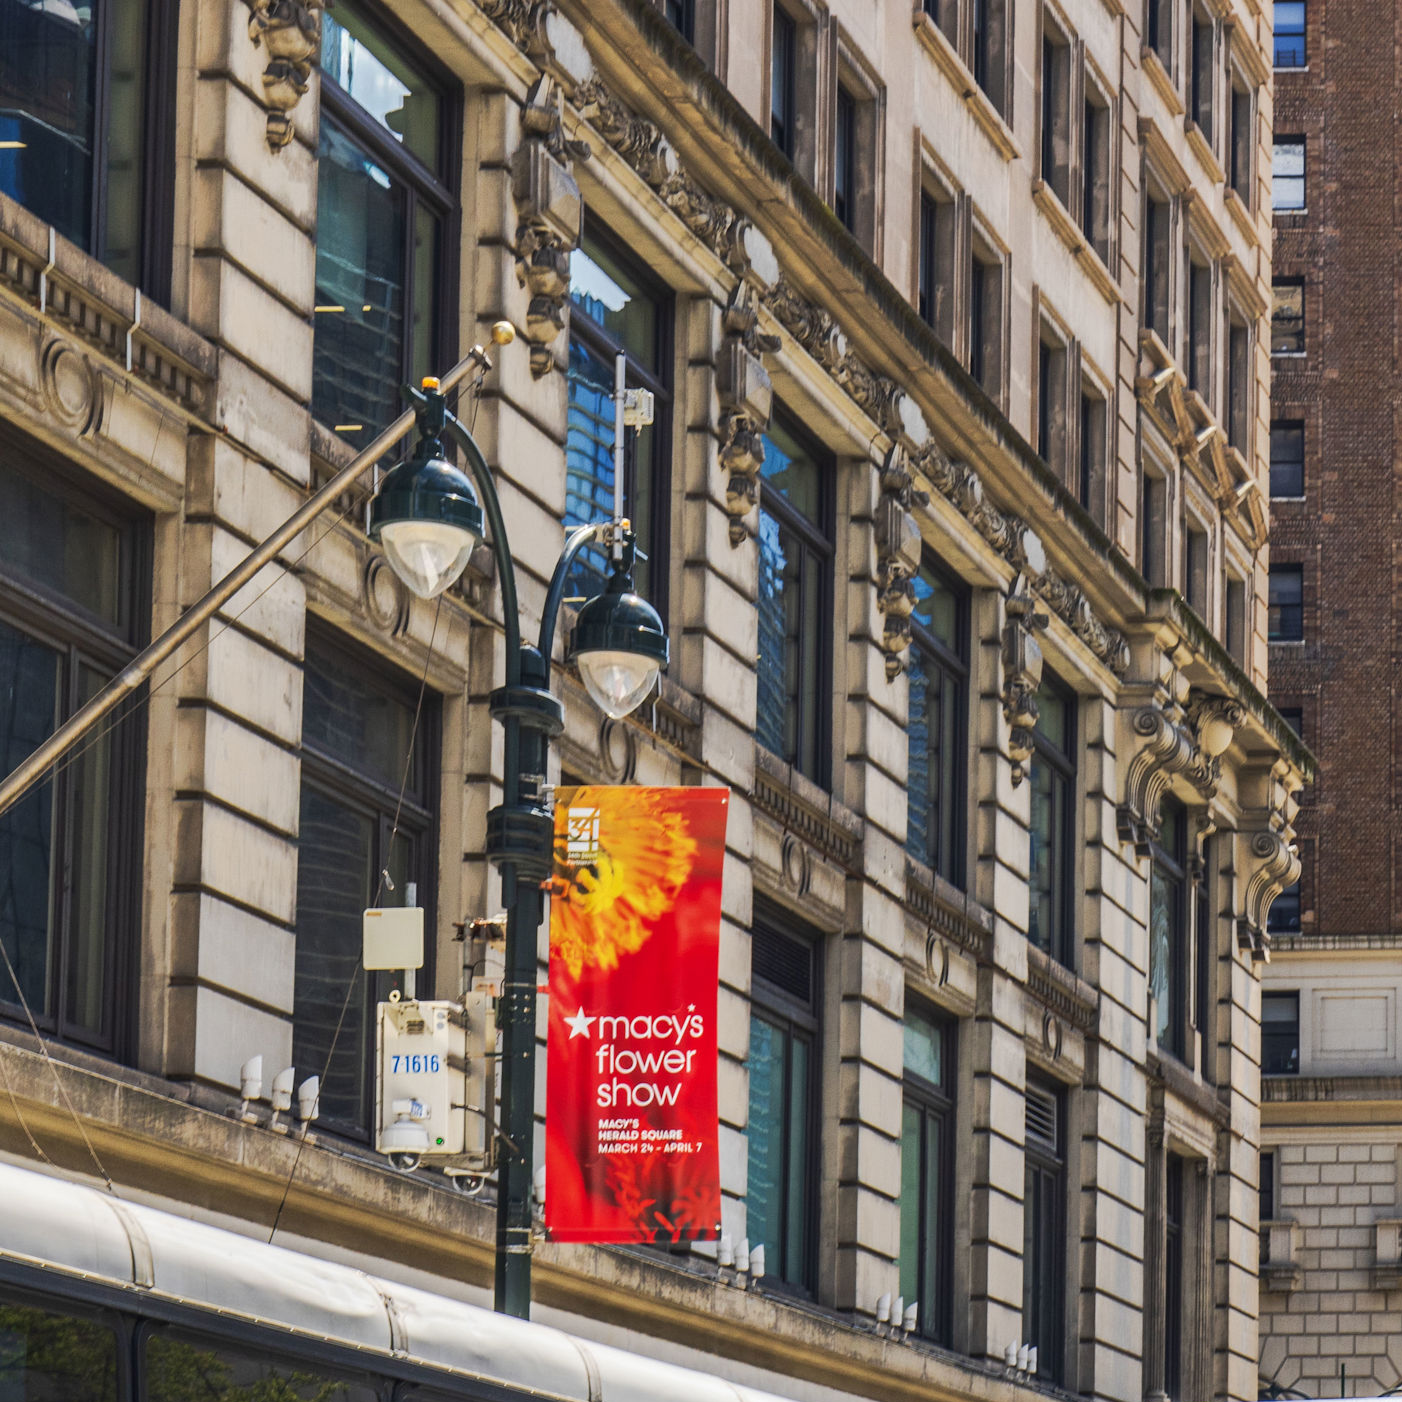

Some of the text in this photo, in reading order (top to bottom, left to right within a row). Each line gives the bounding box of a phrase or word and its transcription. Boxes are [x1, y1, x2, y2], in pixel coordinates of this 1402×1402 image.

[595, 1044, 697, 1075] flower
[596, 1077, 683, 1108] show
[598, 1119, 640, 1130] MACY'S
[598, 1129, 683, 1142] HERALD SQUARE
[598, 1142, 638, 1154] MARCH
[640, 1142, 654, 1153] 24
[663, 1142, 693, 1153] APRIL
[696, 1142, 703, 1153] 7
